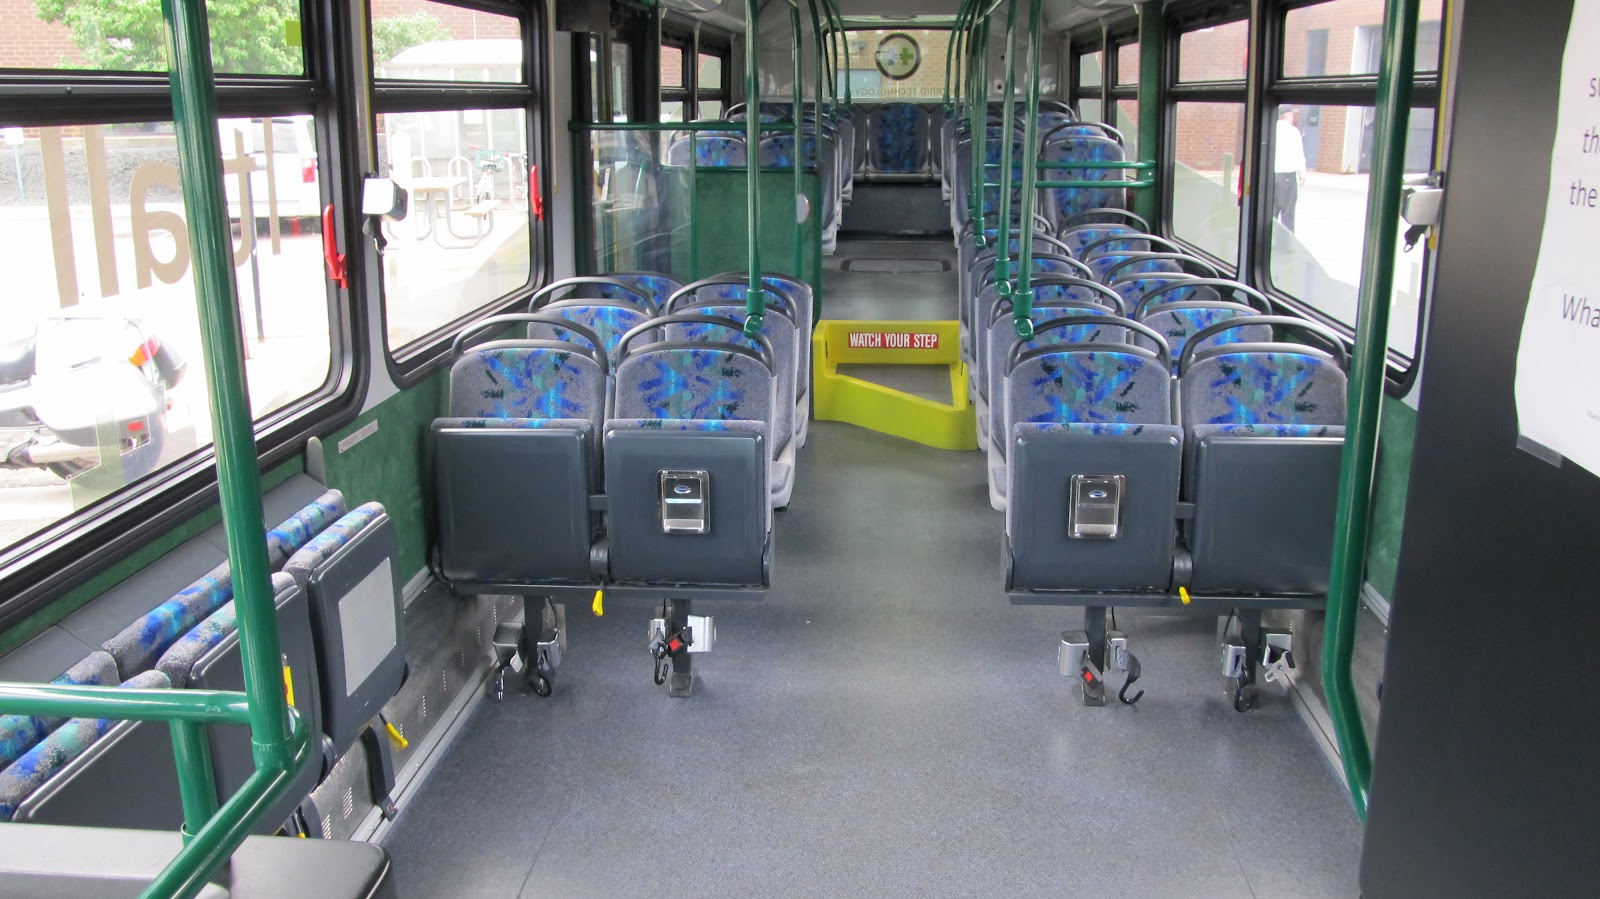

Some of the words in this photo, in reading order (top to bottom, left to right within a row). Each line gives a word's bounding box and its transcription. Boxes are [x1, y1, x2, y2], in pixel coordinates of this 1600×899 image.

[1582, 126, 1600, 154] th
[1569, 178, 1598, 208] the
[849, 333, 881, 347] WATCH
[885, 333, 910, 348] YOUR
[913, 334, 938, 348] STEP
